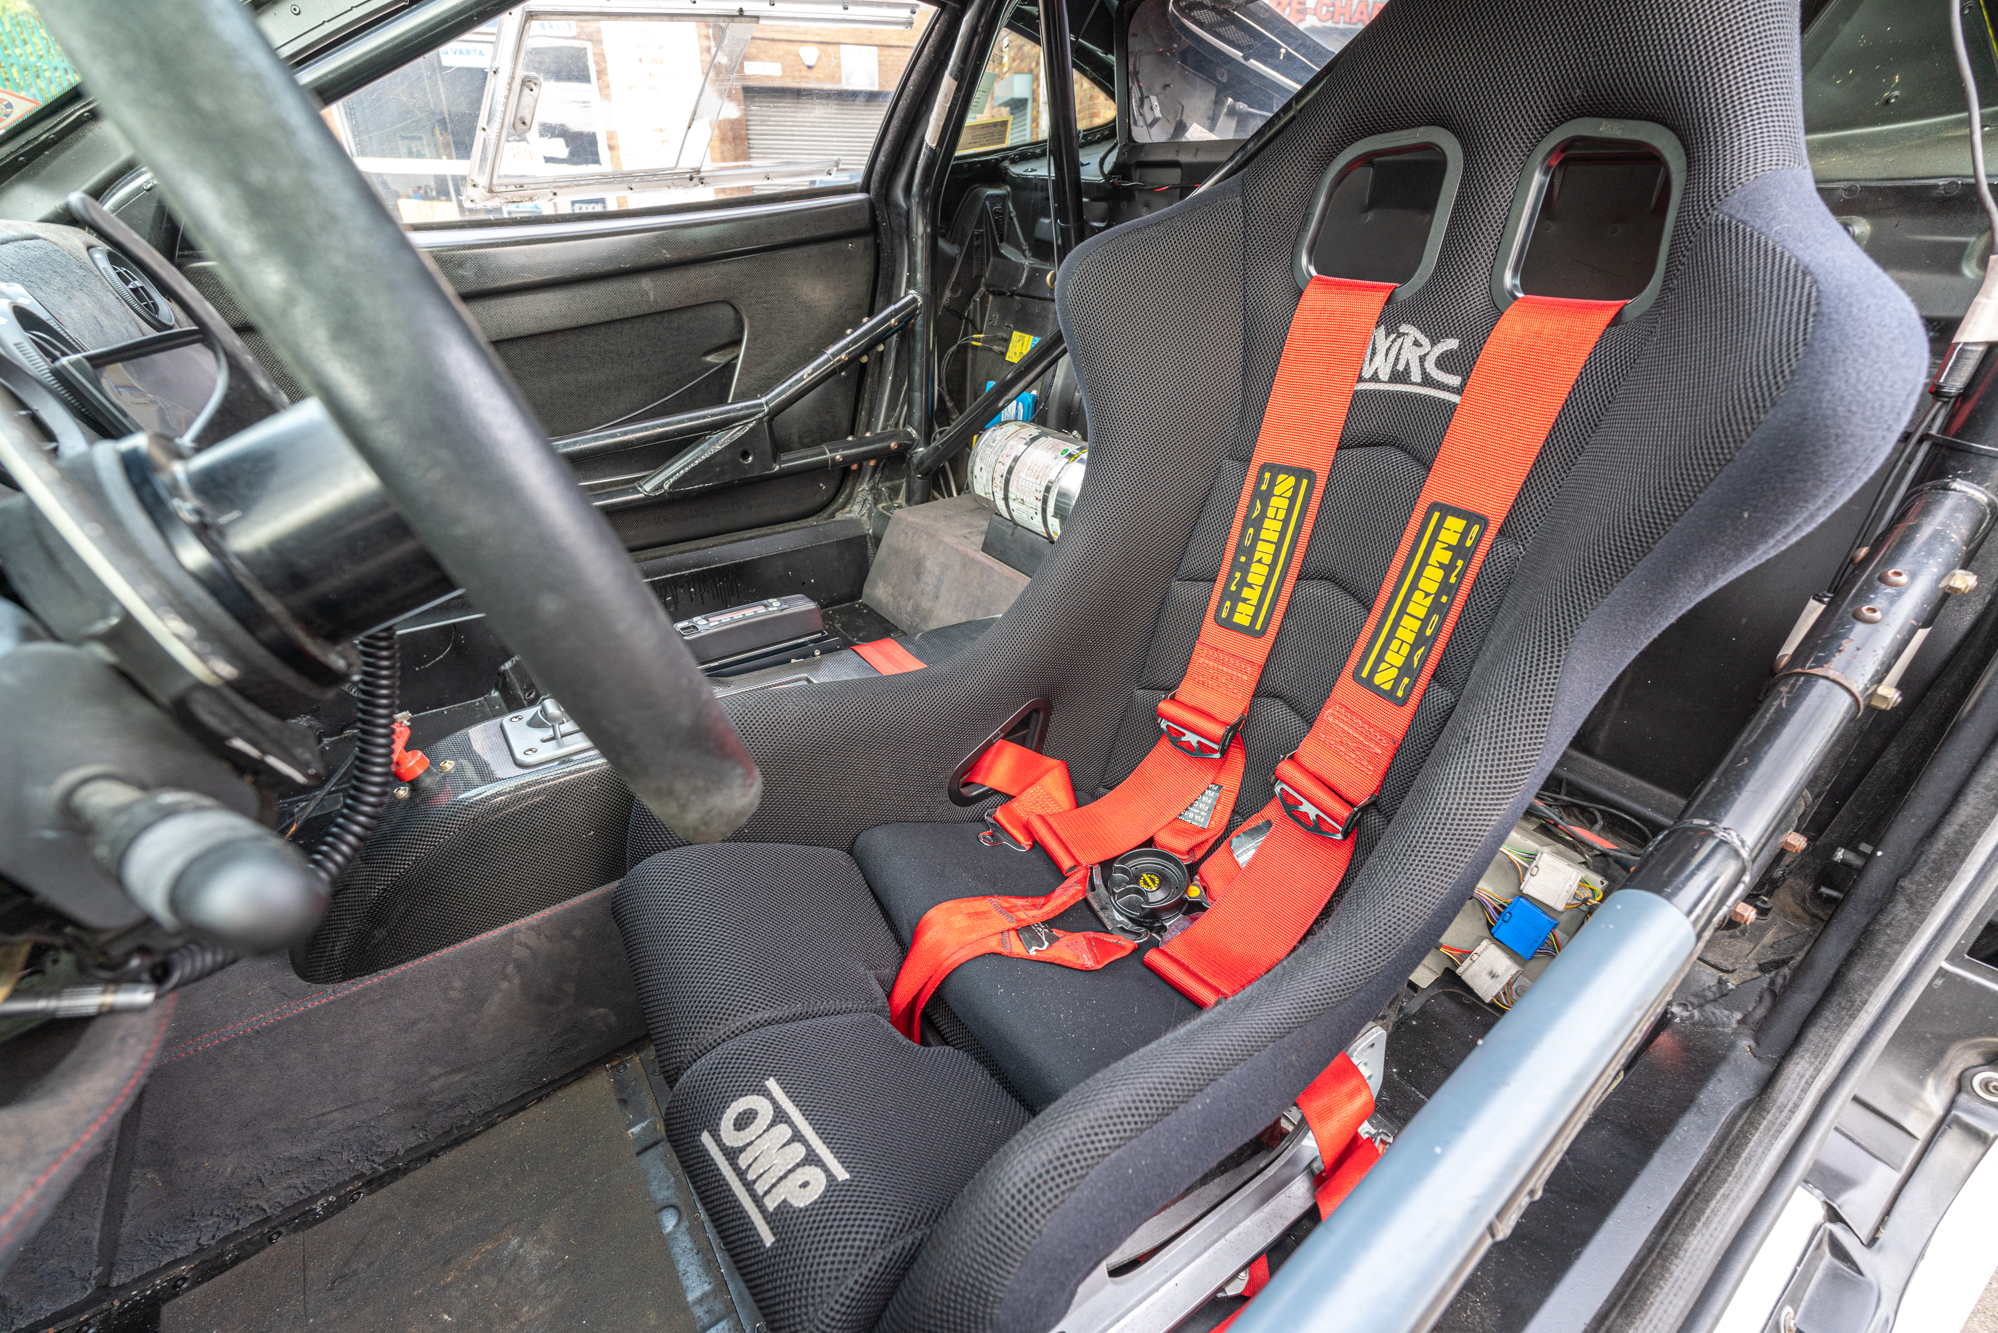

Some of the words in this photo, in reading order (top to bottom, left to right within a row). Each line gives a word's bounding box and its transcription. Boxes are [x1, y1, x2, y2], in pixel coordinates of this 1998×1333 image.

[450, 48, 485, 57] VARTA
[1361, 324, 1462, 387] WRC
[1222, 472, 1271, 618] RACING
[1233, 474, 1295, 626] SCHROTH
[1374, 515, 1467, 690] SCHROTH
[1396, 524, 1480, 697] RACING
[1194, 813, 1205, 823] FIA
[1199, 802, 1209, 811] FIA
[1202, 795, 1212, 804] FIA
[719, 1094, 827, 1212] OMP
